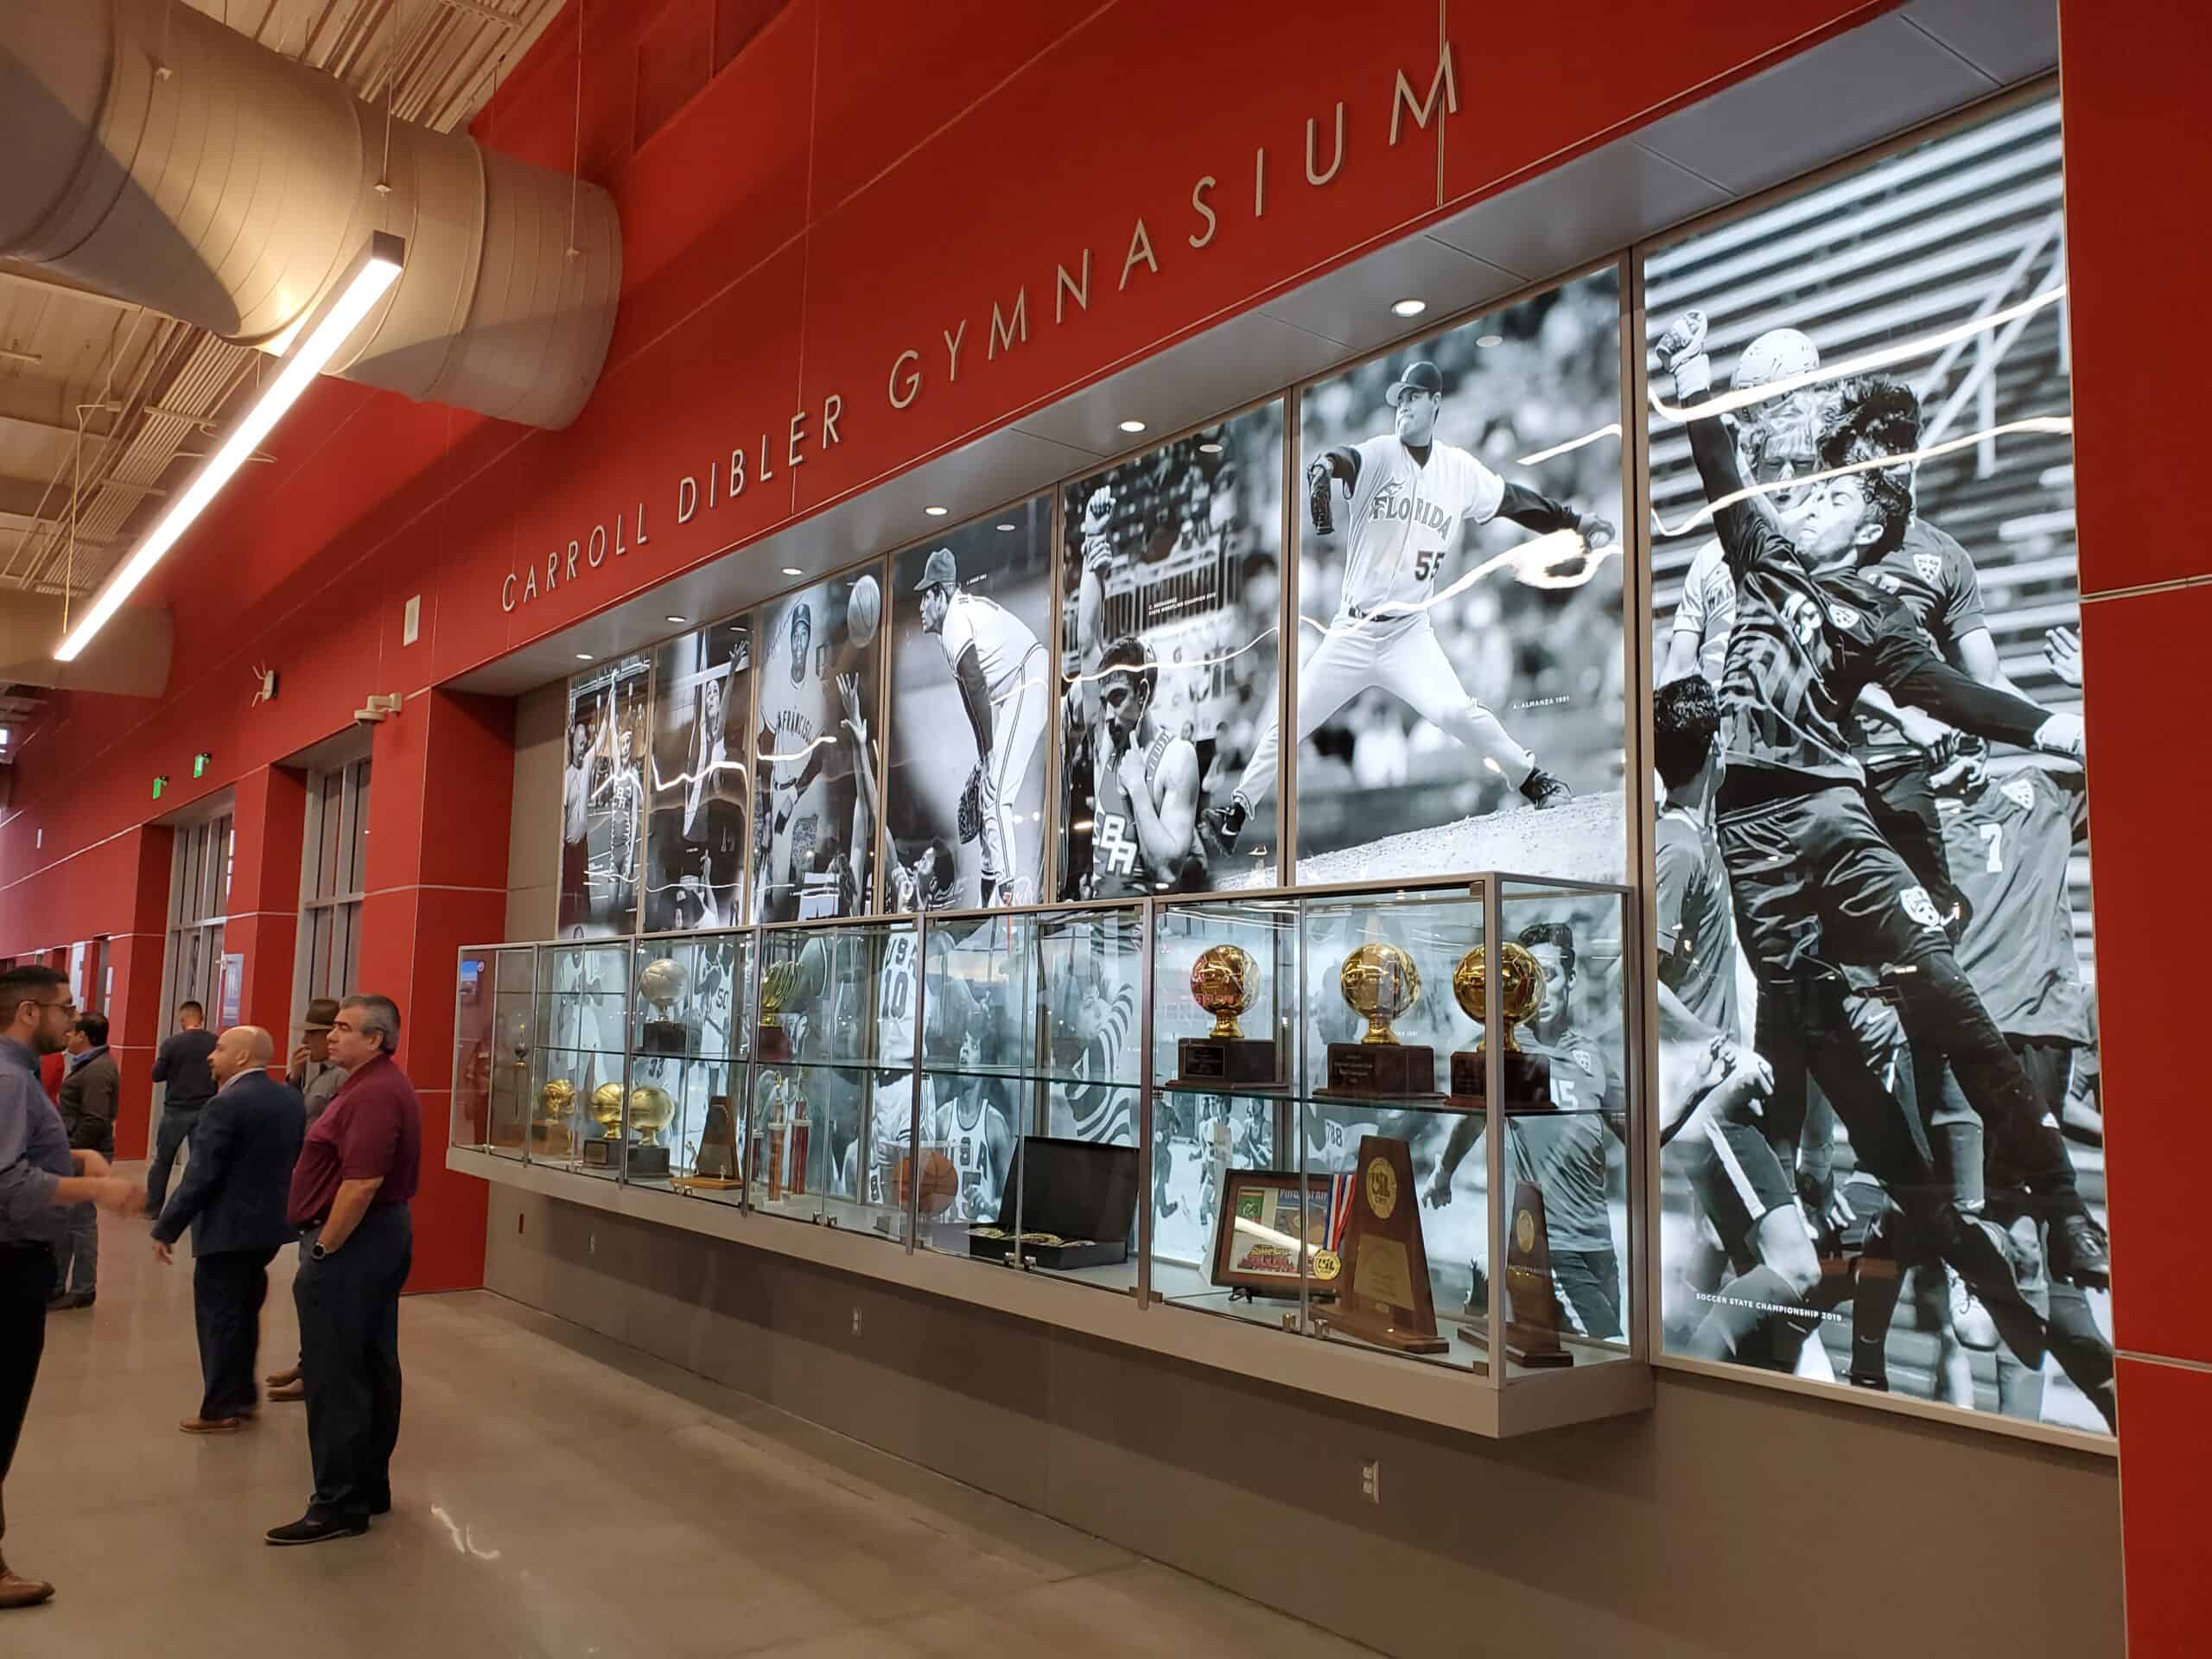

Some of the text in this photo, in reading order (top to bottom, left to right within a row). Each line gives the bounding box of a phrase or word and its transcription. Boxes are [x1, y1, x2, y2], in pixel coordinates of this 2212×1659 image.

[501, 41, 1458, 613] CARROLL DIBLER GYMNASIUM
[1369, 495, 1452, 543] FLORIDA
[1979, 823, 2003, 873] 7
[882, 969, 909, 1020] 10
[1695, 1293, 1727, 1305] SOCCER
[1729, 1298, 1753, 1308] STATE
[1756, 1302, 1819, 1318] CHAMPIONSHIP
